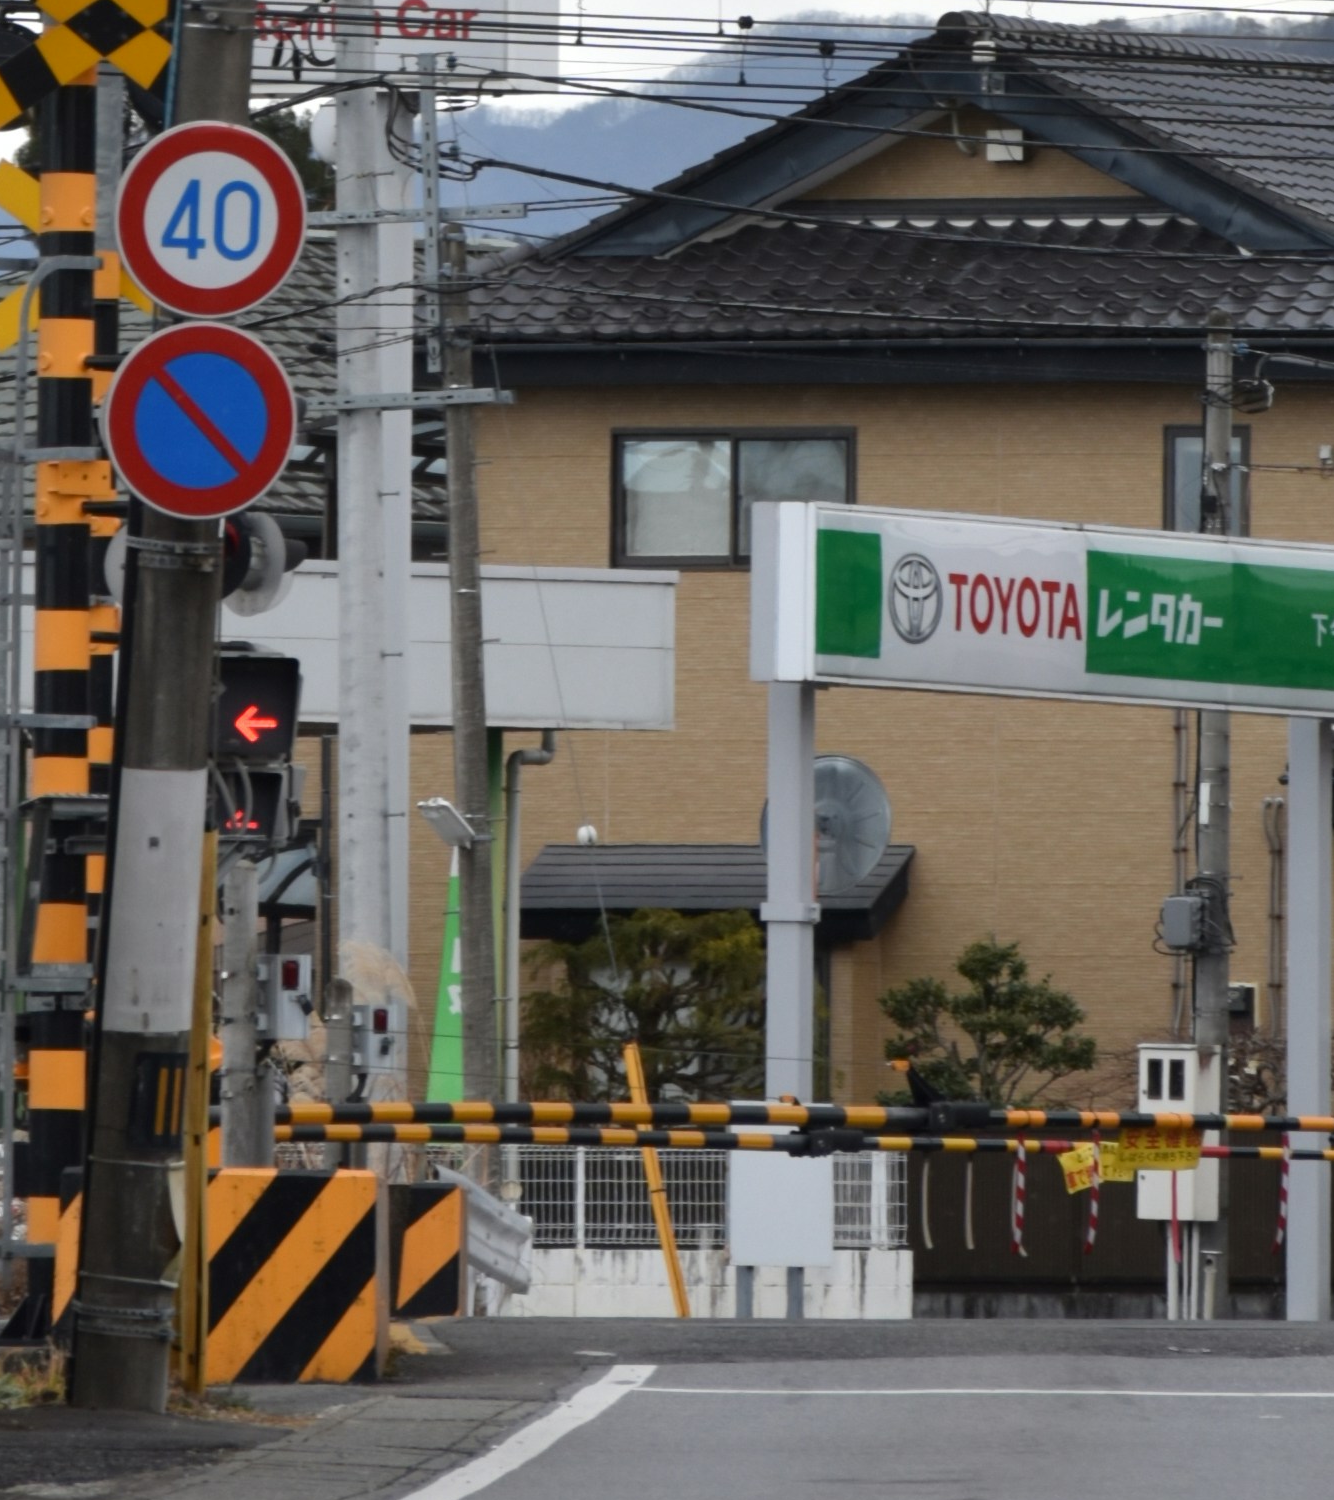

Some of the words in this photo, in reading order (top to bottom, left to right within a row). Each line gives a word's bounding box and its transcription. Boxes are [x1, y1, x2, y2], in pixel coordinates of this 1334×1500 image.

[161, 178, 261, 261] 40
[948, 573, 1083, 641] TOYOTA
[1096, 588, 1224, 646] レンタカー
